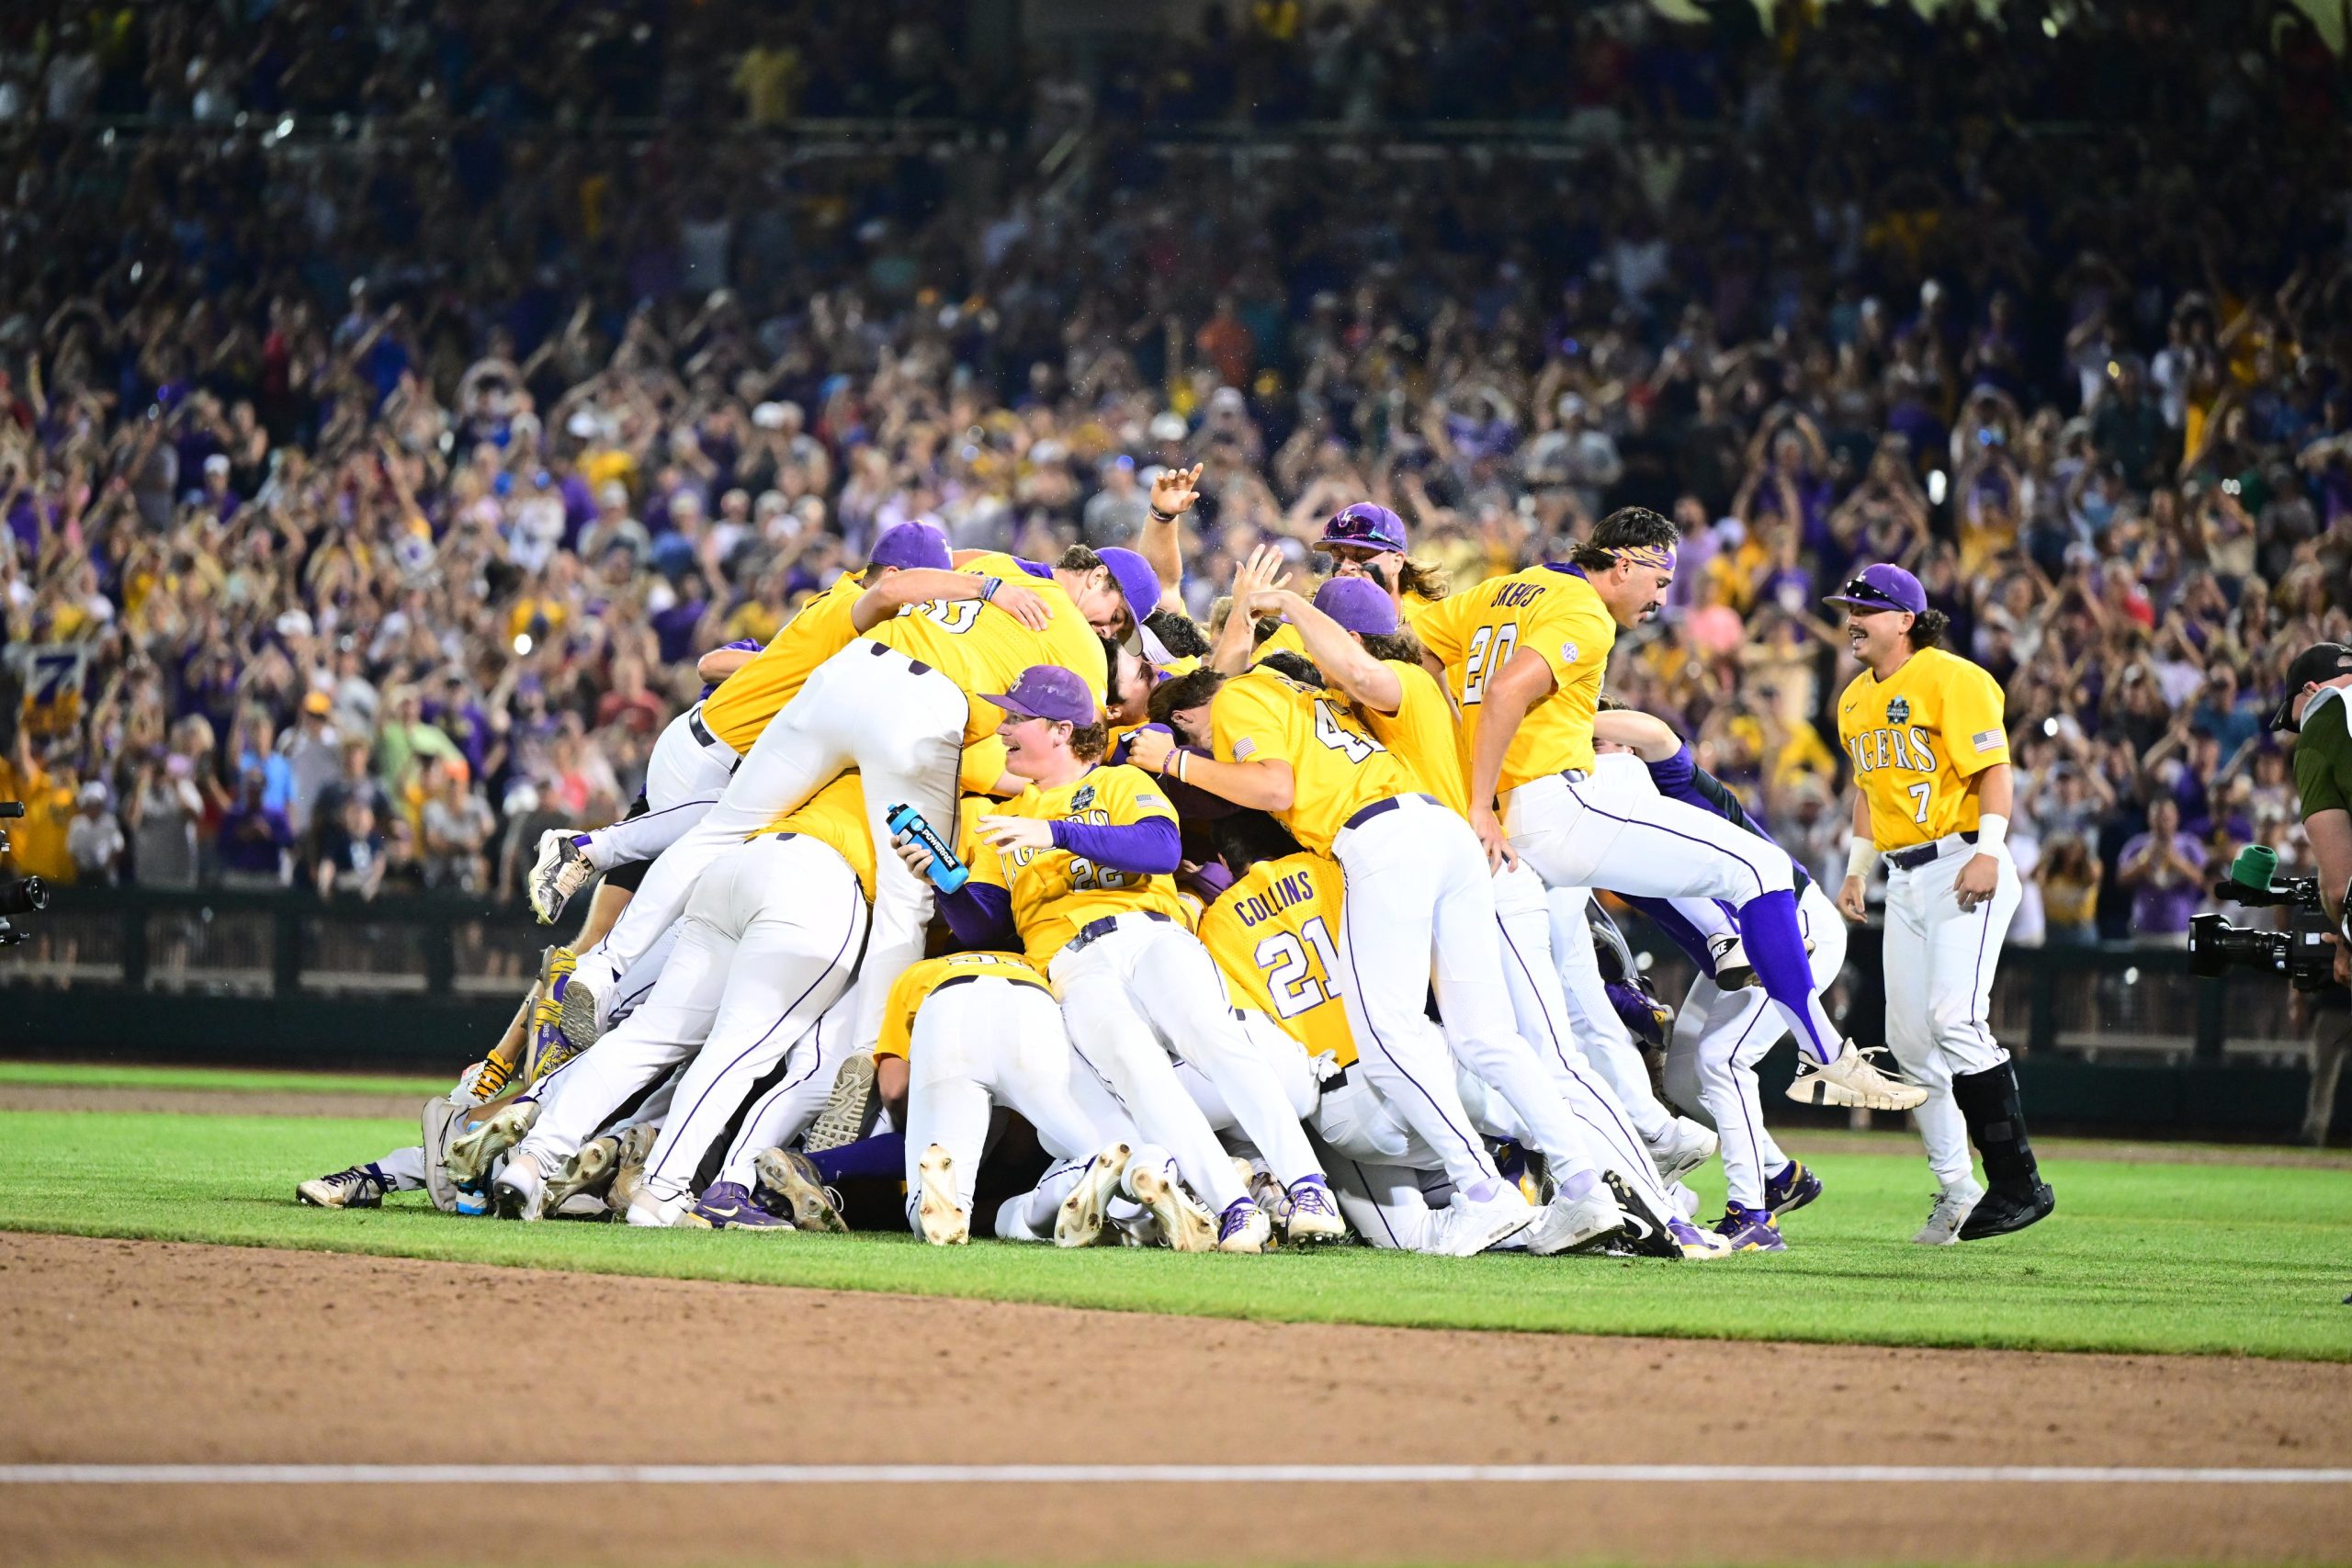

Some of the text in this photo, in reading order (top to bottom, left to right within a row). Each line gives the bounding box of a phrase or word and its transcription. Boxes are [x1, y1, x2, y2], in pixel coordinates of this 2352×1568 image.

[1463, 621, 1519, 707] 20
[1907, 781, 1932, 825] 7
[921, 828, 957, 869] POWERADE
[1233, 870, 1315, 928] COLLINS
[1253, 915, 1343, 1021] 21
